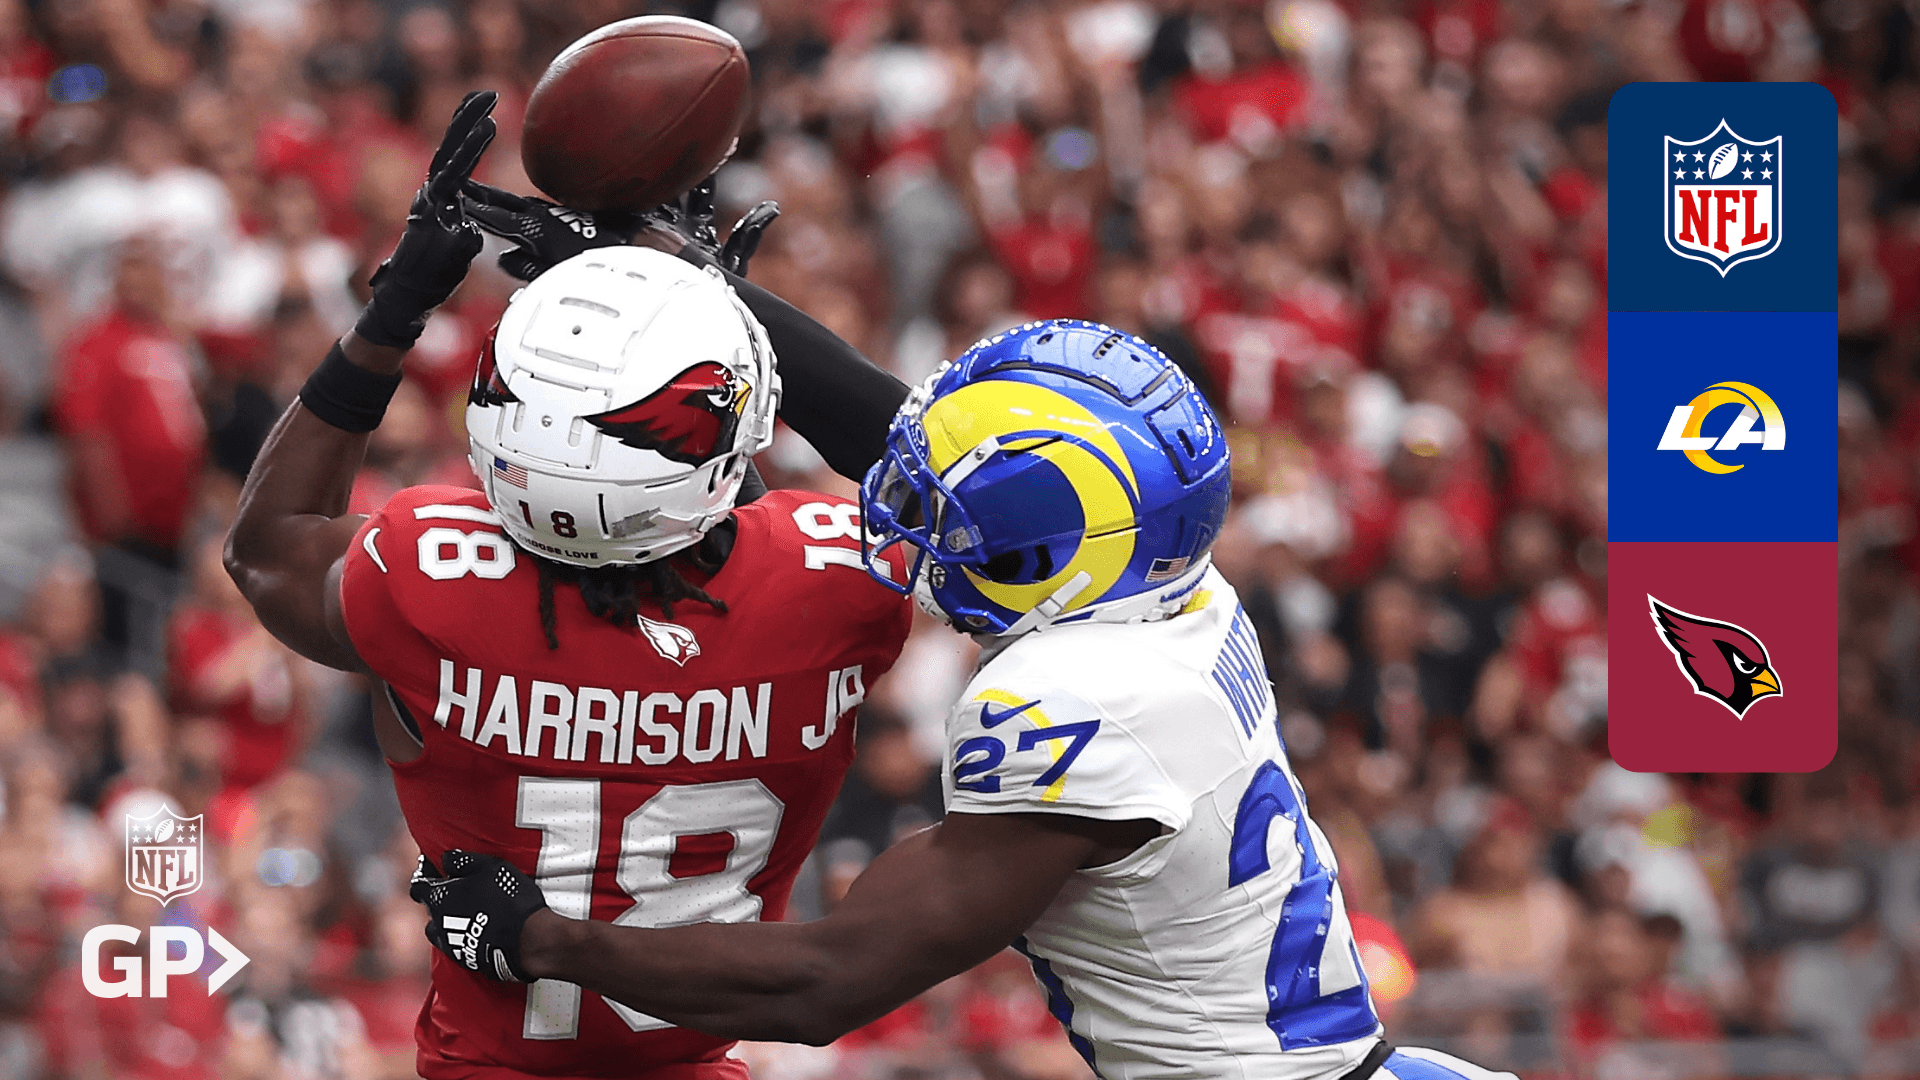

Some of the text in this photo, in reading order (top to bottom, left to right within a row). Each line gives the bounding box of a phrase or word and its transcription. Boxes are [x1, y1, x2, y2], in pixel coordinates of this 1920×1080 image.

[413, 504, 516, 580] 18
[517, 532, 598, 559] HOOSE LOVE
[518, 499, 578, 538] 18
[791, 502, 891, 579] 18
[434, 659, 771, 765] HARRISON
[955, 719, 1101, 793] 27
[462, 912, 488, 970] adidas
[1228, 759, 1379, 1051] 2
